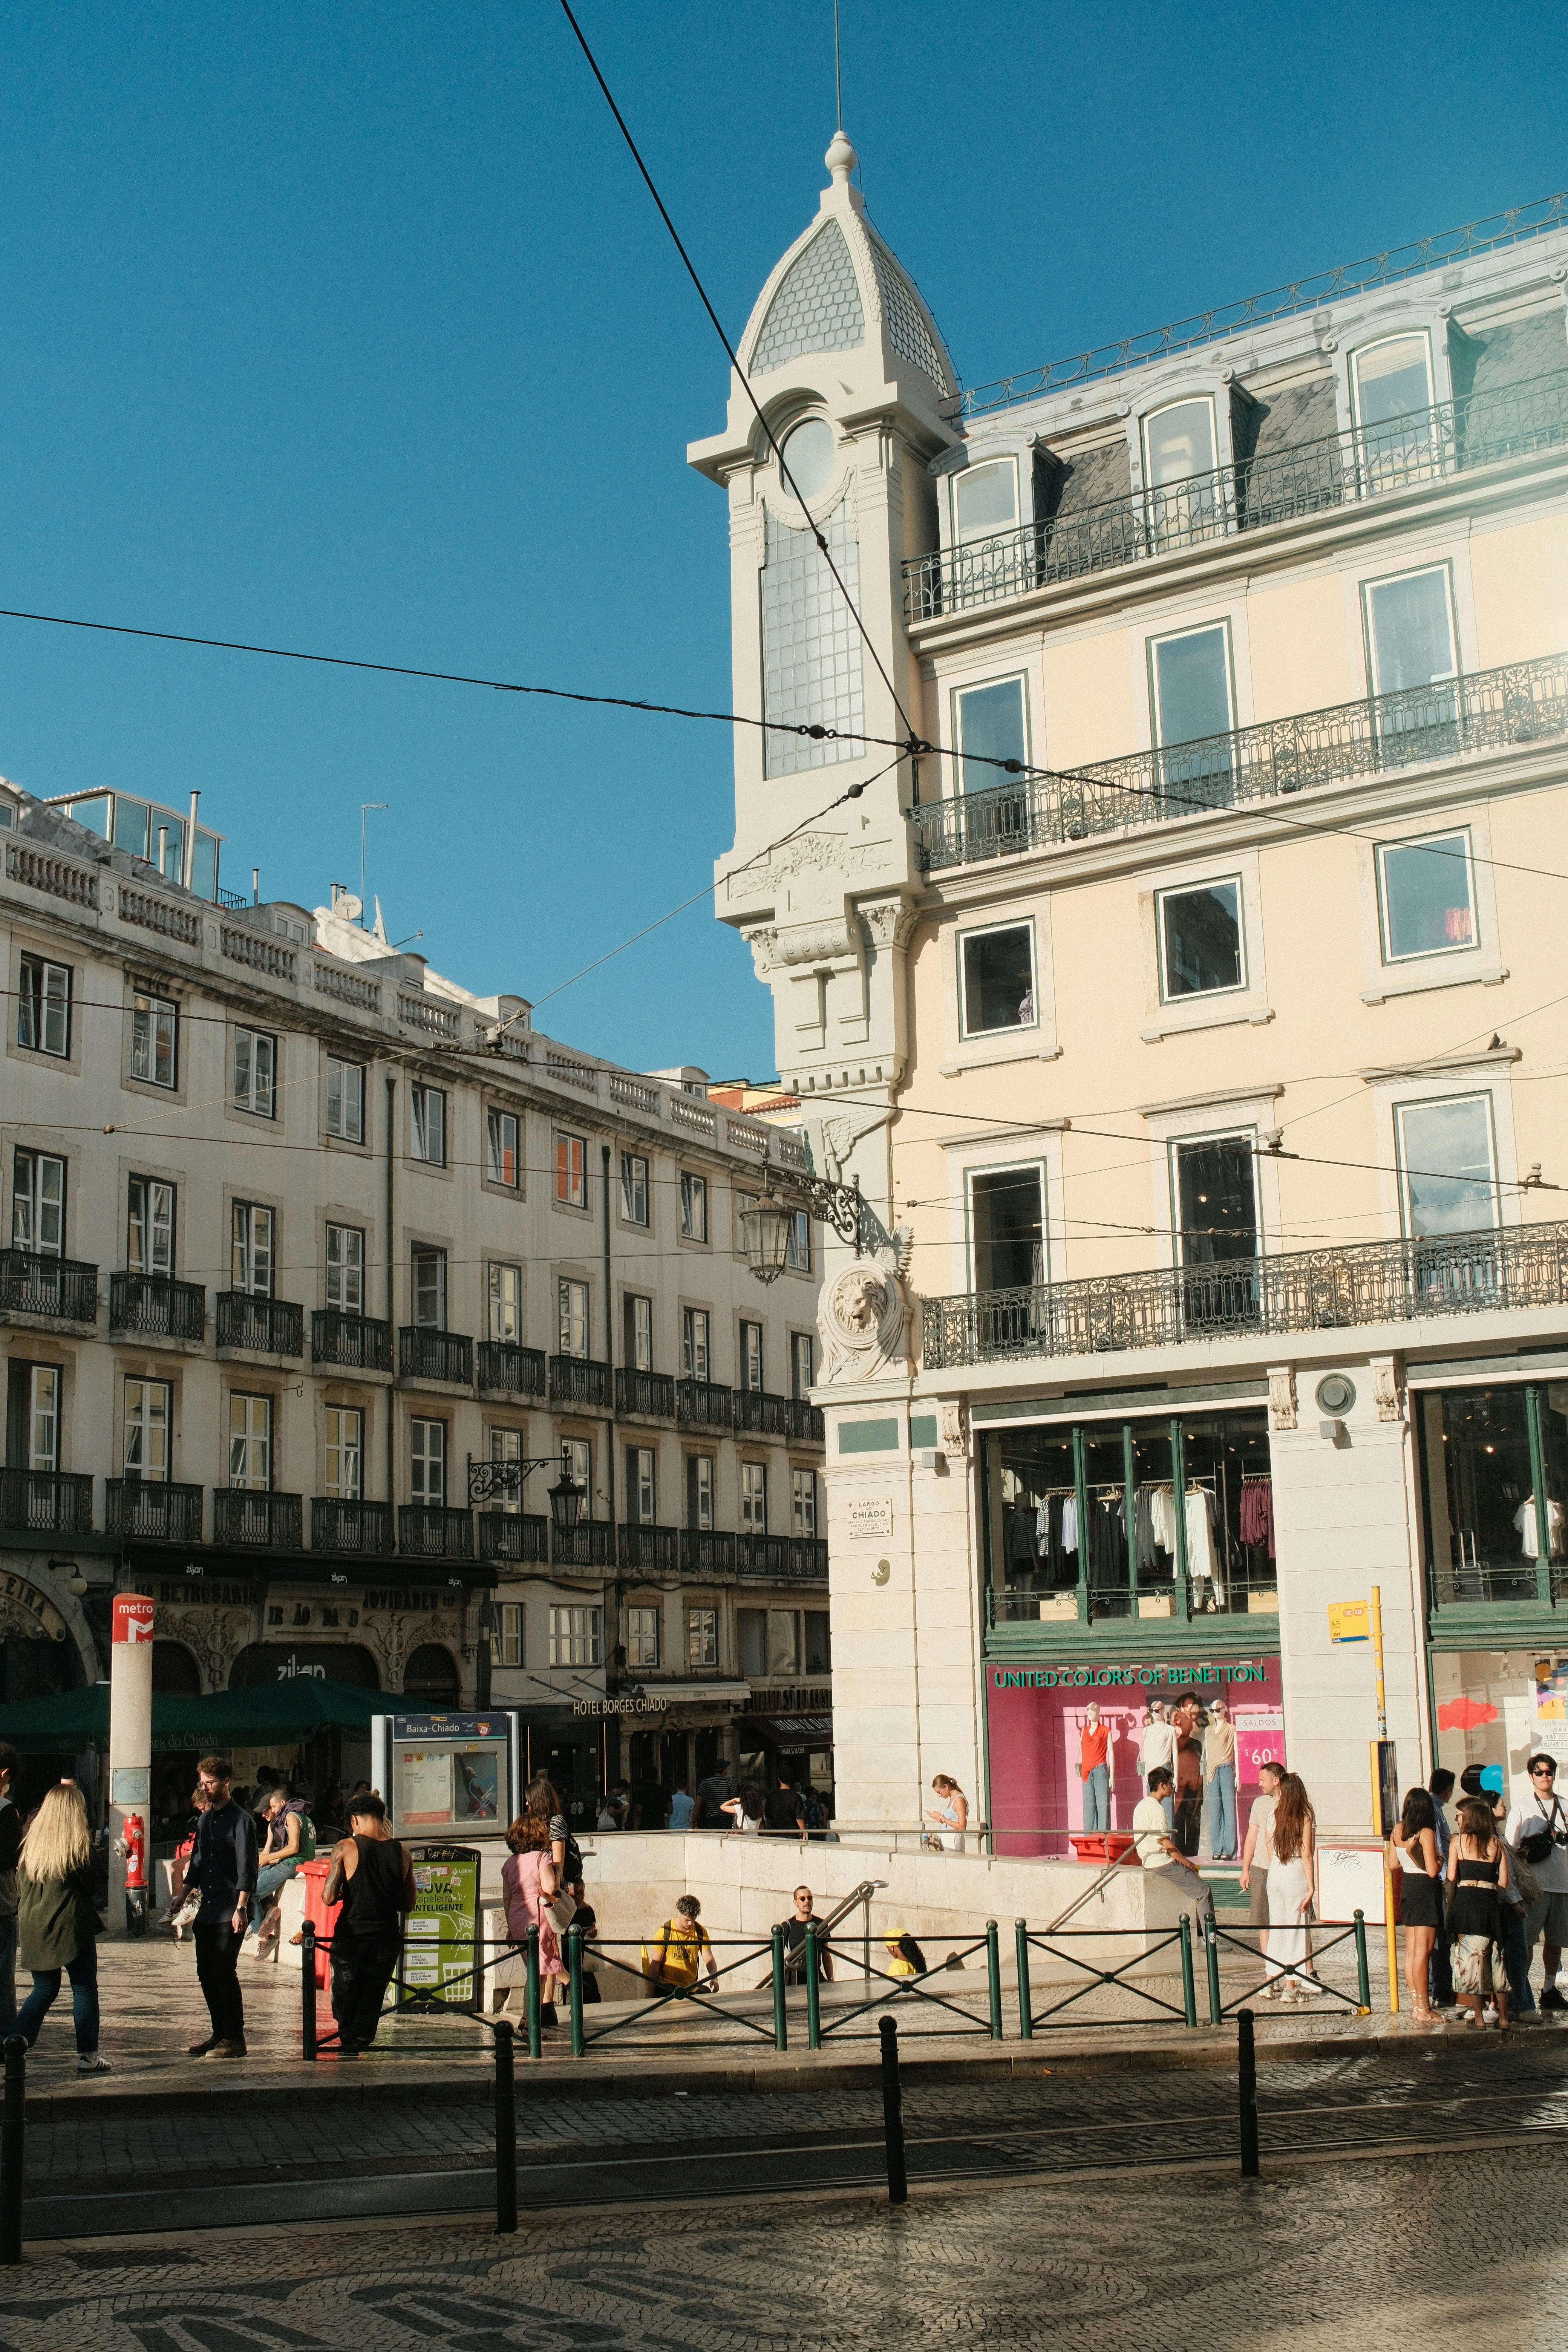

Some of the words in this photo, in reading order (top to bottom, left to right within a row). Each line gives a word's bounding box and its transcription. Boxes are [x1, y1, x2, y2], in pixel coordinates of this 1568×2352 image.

[852, 1510, 886, 1519] CHIADO
[0, 1577, 46, 1616] EIRA
[119, 1603, 153, 1614] metro
[995, 1671, 1058, 1688] UNITED
[1062, 1669, 1134, 1687] COLORS
[1138, 1668, 1163, 1685] OF
[1168, 1665, 1269, 1684] BENETTON.
[574, 1700, 600, 1715] HOTEL
[603, 1698, 634, 1714] BORGES
[636, 1698, 666, 1712] CHIADO
[407, 1723, 459, 1733] Baixa-Chiado
[168, 1735, 181, 1747] do
[184, 1732, 218, 1746] Chiado
